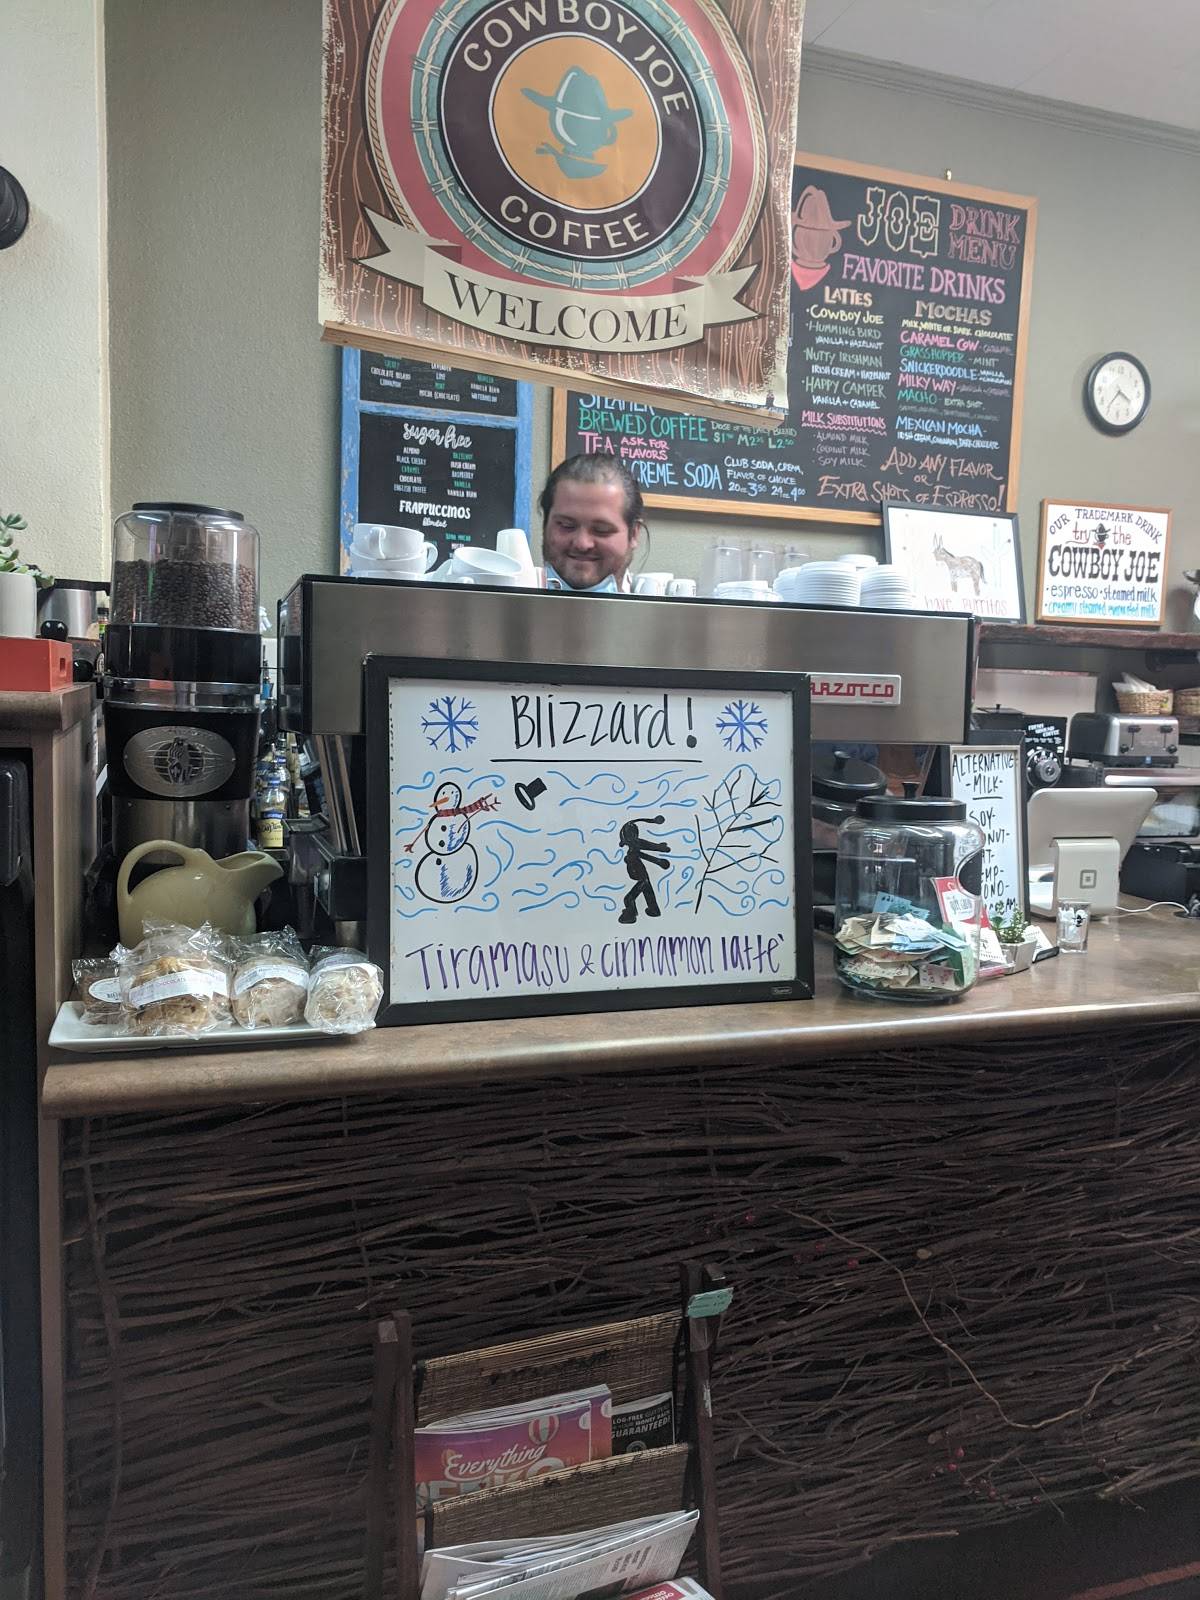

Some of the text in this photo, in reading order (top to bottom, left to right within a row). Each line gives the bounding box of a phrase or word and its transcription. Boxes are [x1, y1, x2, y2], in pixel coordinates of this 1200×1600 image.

[463, 0, 690, 116] COWBOY JOE
[500, 195, 649, 252] COFFEE
[857, 186, 1020, 258] JOE DRINK
[948, 231, 1016, 270] MENU
[842, 253, 1006, 304] FAVORITE DRINKS
[444, 270, 687, 343] WELCOME
[824, 286, 872, 307] LATTES
[810, 304, 884, 325] COWBOY JOE
[915, 300, 992, 326] MOCHAS
[808, 320, 881, 339] HUMMING BIRD
[900, 330, 955, 348] CARAMEL
[956, 339, 980, 351] COW
[805, 347, 883, 367] NUTTY IRISHMAN
[899, 345, 999, 367] GRASSHOPPER MINT
[831, 367, 855, 378] CREAM
[899, 358, 978, 381] SNICKERDOODLE
[805, 376, 886, 399] HAPPY CAMPER
[898, 374, 932, 391] MILKY
[932, 379, 957, 396] WAY
[812, 395, 842, 406] VANILLA
[849, 399, 880, 409] CARAMEL
[897, 389, 938, 405] MACHO
[577, 408, 647, 434] BREWED
[650, 415, 708, 441] COFFEE
[801, 410, 825, 424] MILK
[826, 412, 886, 429] SUBSTITUTIONS
[895, 415, 983, 437] MEXICAN MOCHA
[621, 437, 647, 446] ASK
[649, 439, 670, 450] FOR
[816, 432, 869, 446] ALMOND MILK
[816, 444, 870, 456] COCONUT MILK
[620, 447, 668, 461] FLAVORS
[724, 456, 749, 469] CLUB
[817, 456, 867, 468] SOY MILK
[880, 447, 1004, 481] ADD ANY FLAVOR
[683, 462, 722, 490] SODA
[727, 469, 757, 481] FLAVOR
[768, 475, 796, 485] CHOICE
[914, 474, 932, 487] OR
[817, 475, 869, 501] EXTRA
[871, 481, 910, 502] SHOTS
[915, 492, 930, 503] OF
[1049, 508, 1162, 544] OUR TRADEMARK DRINK
[1066, 521, 1132, 545] try the
[1048, 544, 1161, 583] COWBOY JOE
[1051, 585, 1158, 602] espresso steamed milk
[511, 694, 698, 750] Blizzard!
[952, 752, 1014, 783] ALTERNATIVE
[405, 942, 571, 991] Tiramasu
[578, 944, 596, 976] &
[601, 936, 714, 978] cinnamon
[445, 1444, 547, 1482] Everything
